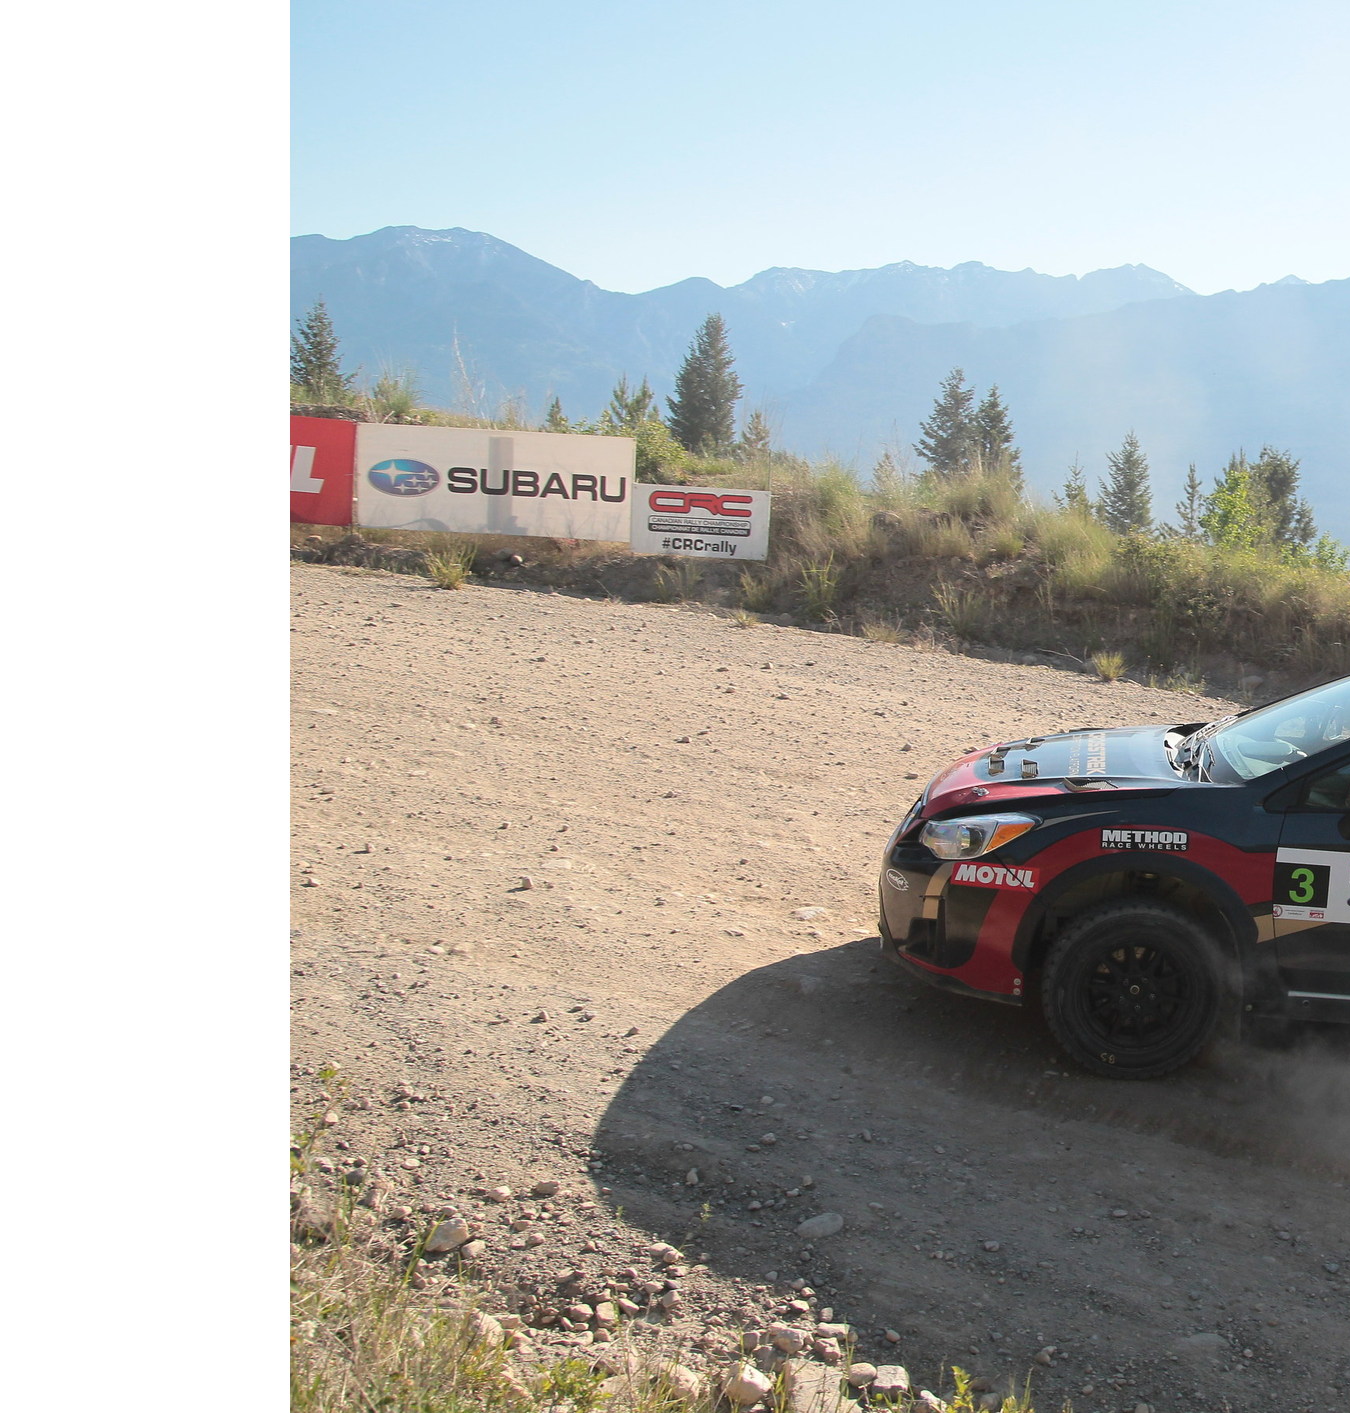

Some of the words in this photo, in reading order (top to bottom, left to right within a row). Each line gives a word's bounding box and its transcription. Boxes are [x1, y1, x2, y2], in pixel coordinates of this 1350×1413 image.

[290, 444, 325, 494] L
[447, 467, 626, 503] SUBARU
[649, 490, 753, 518] CRC
[652, 525, 691, 533] CHAMPIONNAT
[684, 518, 701, 526] RALLY
[703, 520, 749, 528] CHAMPIONSHIP
[662, 537, 737, 556] #CRCrally
[1102, 829, 1188, 844] METHOD
[1138, 843, 1187, 851] WHEELS
[954, 863, 1036, 888] MOTUL
[1288, 867, 1315, 903] 3
